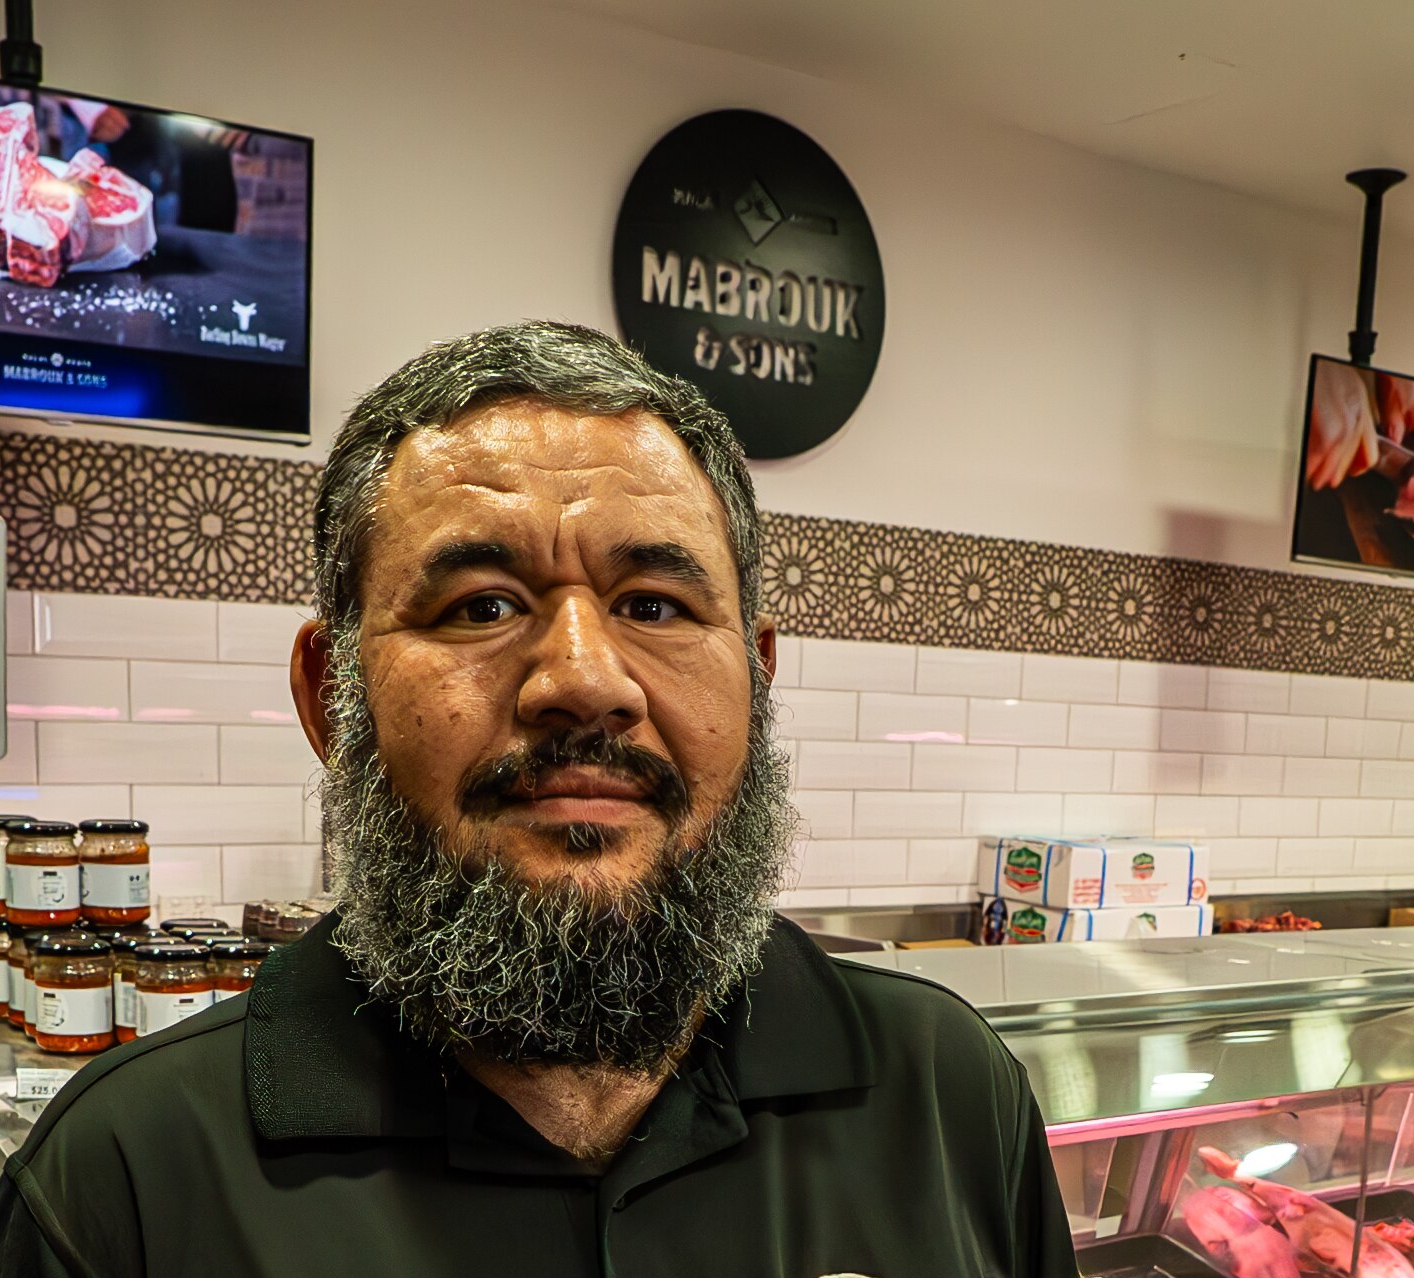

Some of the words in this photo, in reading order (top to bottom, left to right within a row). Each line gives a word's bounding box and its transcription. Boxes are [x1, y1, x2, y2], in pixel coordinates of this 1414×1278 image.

[642, 246, 863, 339] MABROUK
[694, 326, 721, 371] &
[729, 335, 817, 386] SONS
